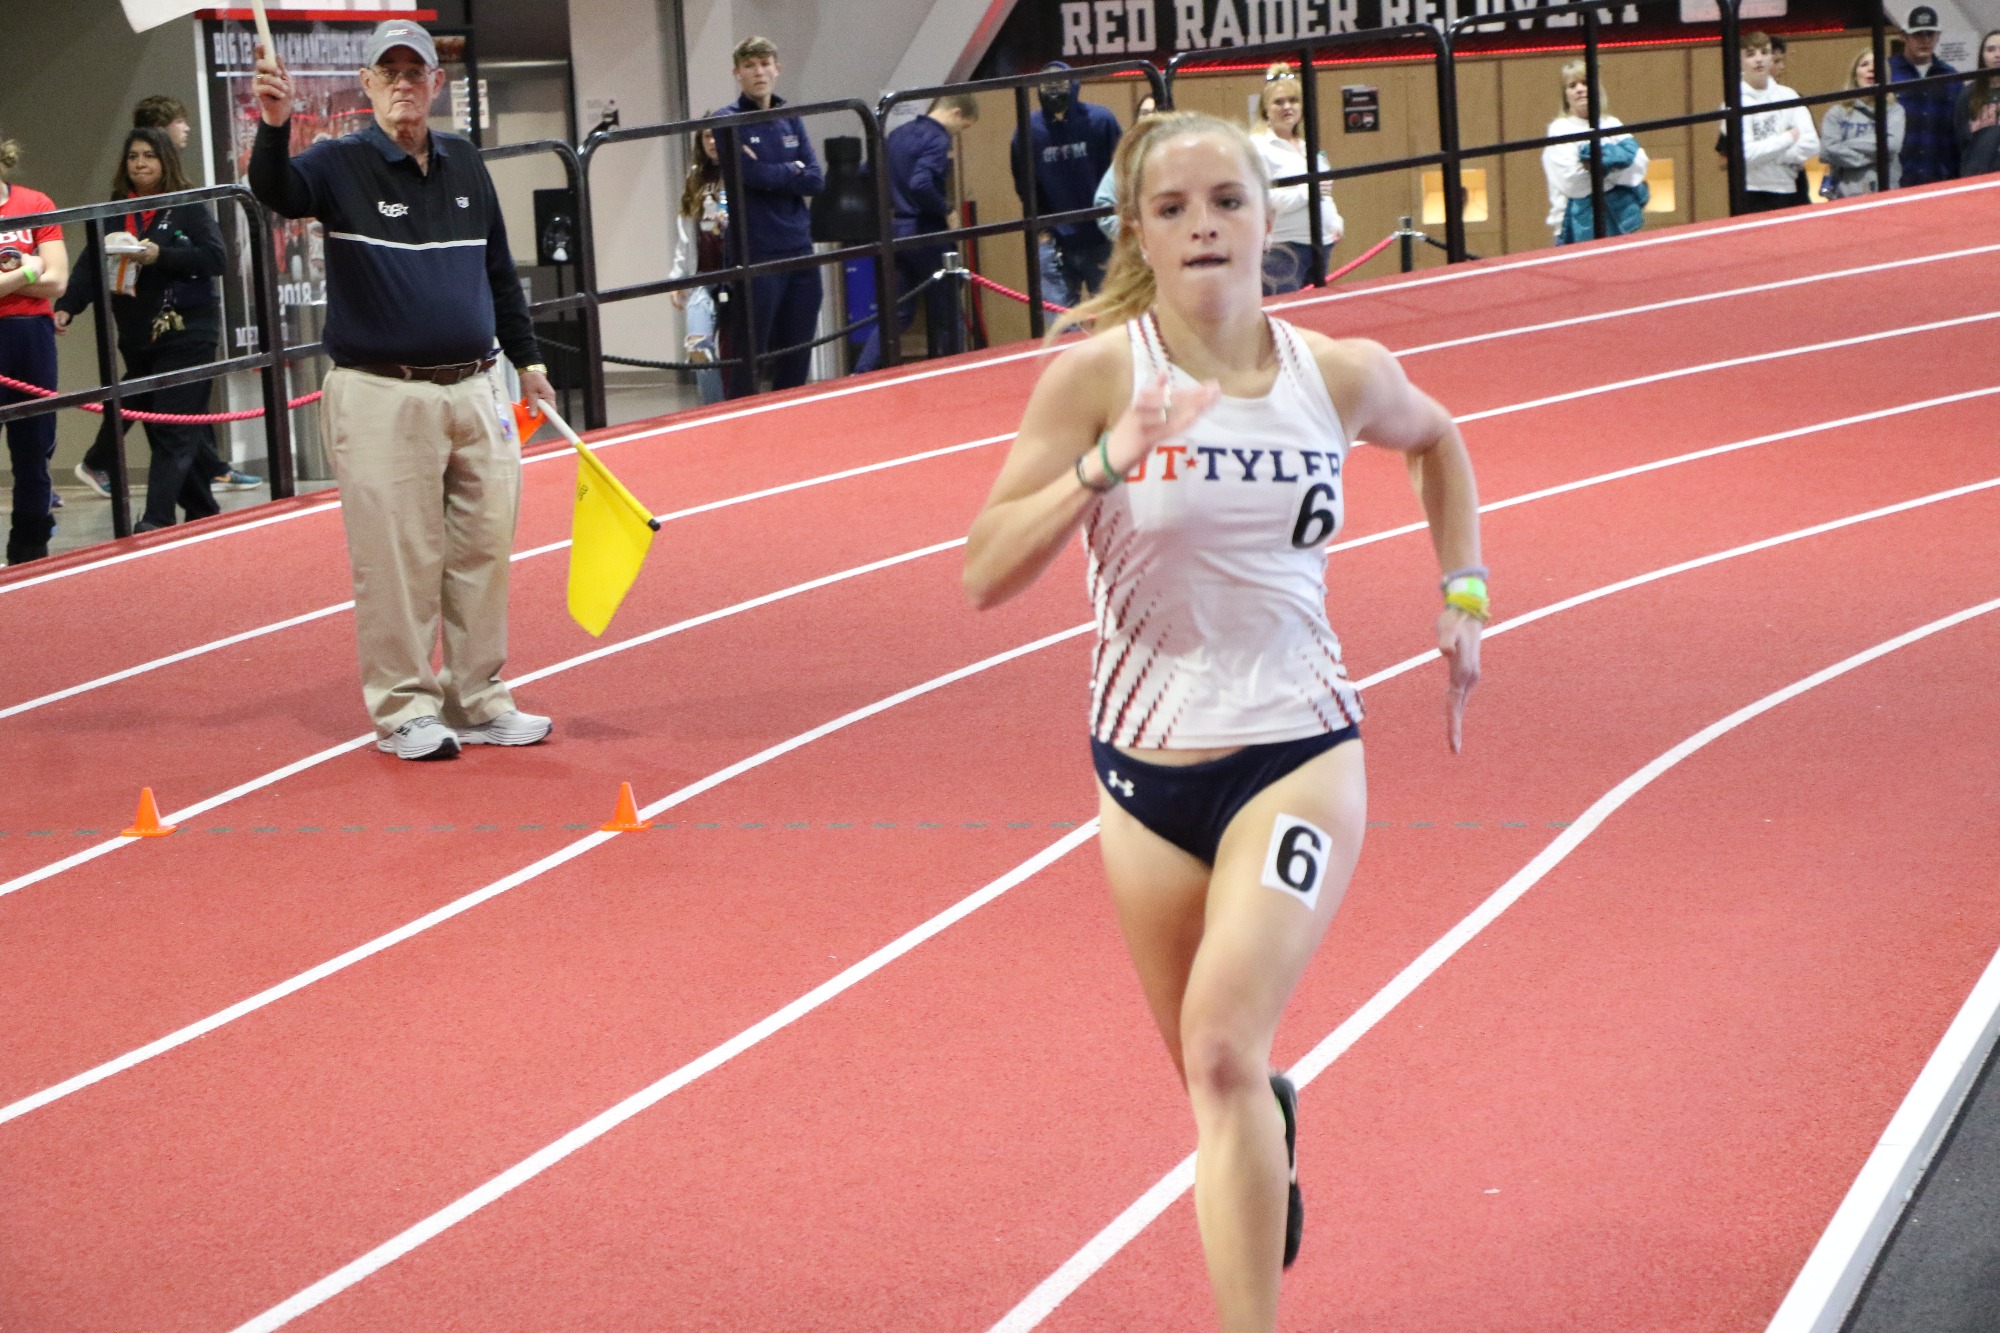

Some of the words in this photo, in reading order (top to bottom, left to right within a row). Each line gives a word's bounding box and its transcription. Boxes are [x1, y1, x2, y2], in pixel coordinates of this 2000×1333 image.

[1060, 0, 1157, 56] RED
[1173, 0, 1359, 50] RAIDER
[1292, 482, 1337, 550] 6
[1276, 825, 1322, 893] 6
